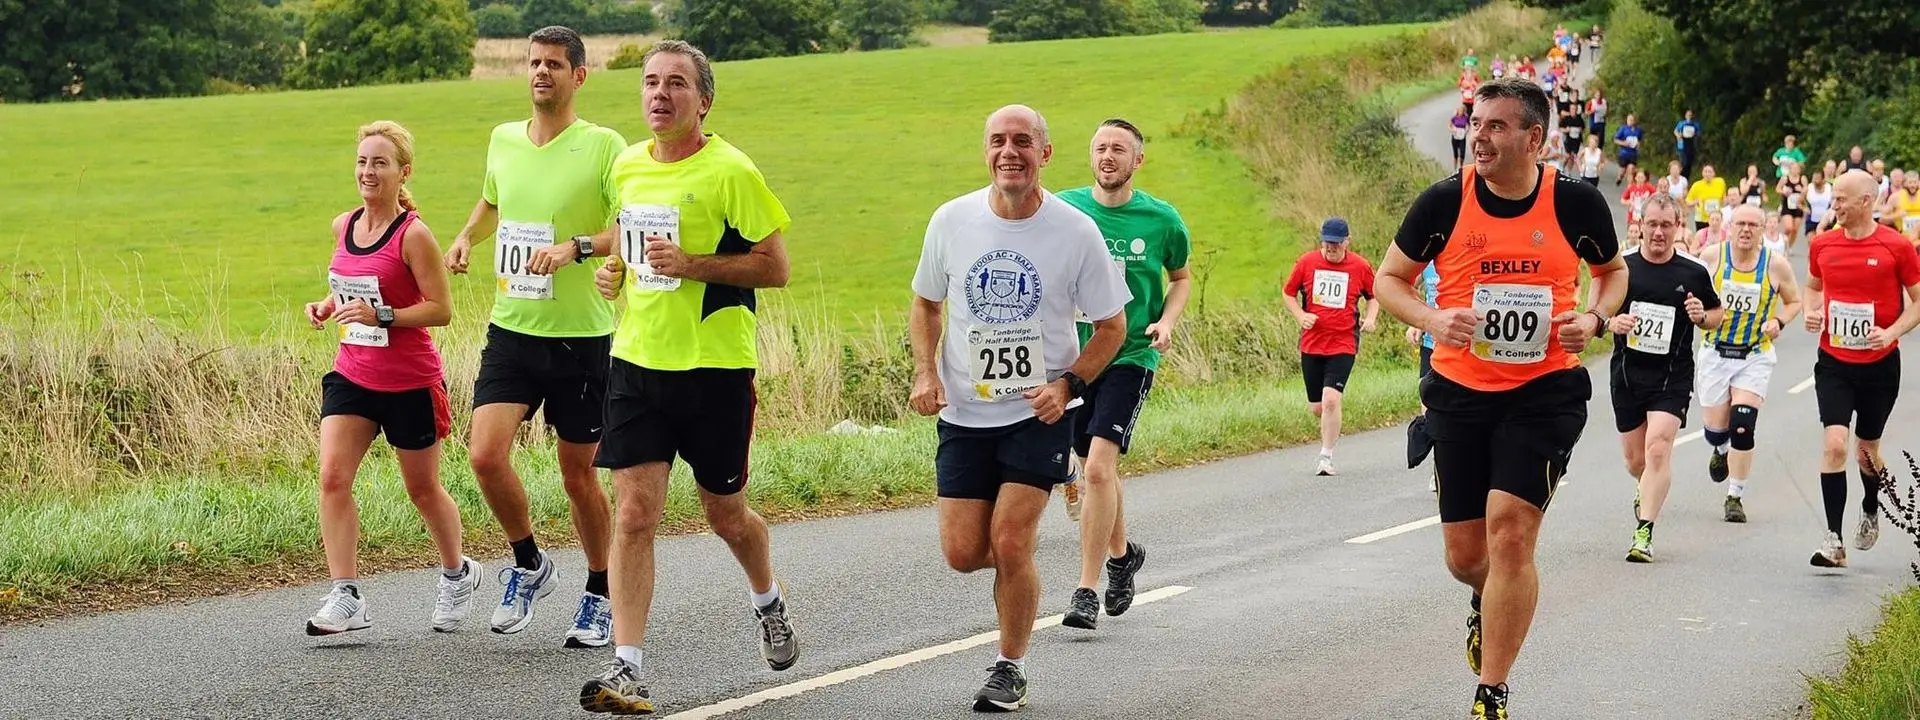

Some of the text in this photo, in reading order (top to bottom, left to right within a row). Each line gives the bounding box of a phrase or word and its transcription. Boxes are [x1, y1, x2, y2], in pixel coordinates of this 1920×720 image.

[995, 251, 1008, 259] AC
[1480, 260, 1541, 275] BEXLEY
[643, 275, 675, 284] College
[517, 284, 547, 294] College
[1014, 254, 1041, 319] HALF MARATHON
[1319, 281, 1341, 297] 210
[1503, 291, 1544, 300] Tonbridge
[1512, 300, 1551, 308] Marathon
[1726, 293, 1753, 312] 965
[1483, 309, 1539, 342] 809
[1633, 315, 1664, 339] 324
[992, 327, 1032, 337] Tonbridge
[984, 335, 1041, 345] Half Marathon
[1505, 349, 1541, 358] College
[979, 345, 1032, 380] 258
